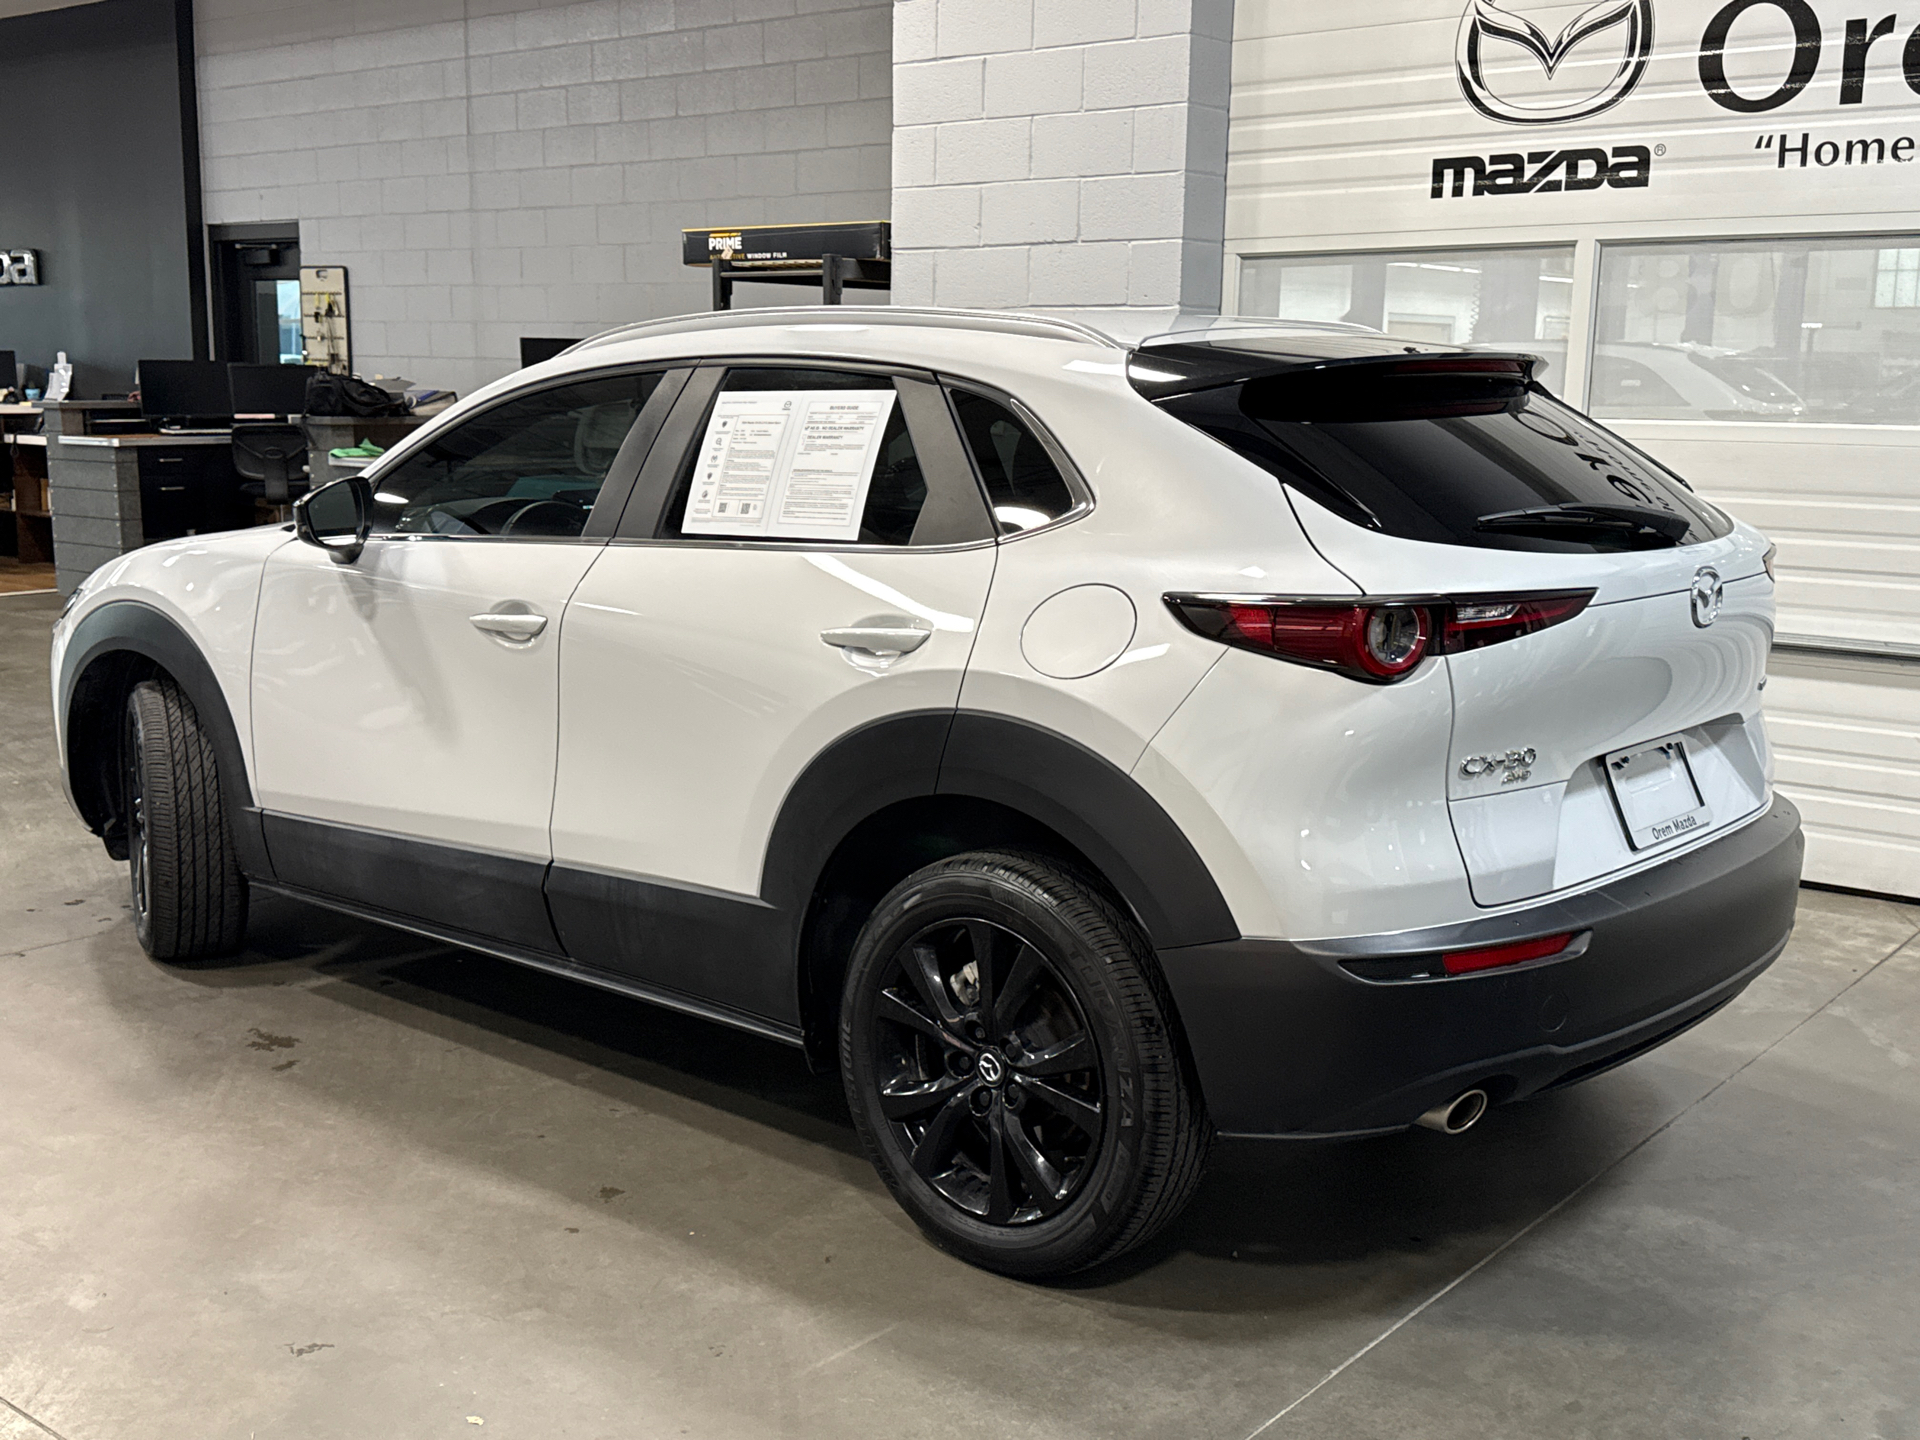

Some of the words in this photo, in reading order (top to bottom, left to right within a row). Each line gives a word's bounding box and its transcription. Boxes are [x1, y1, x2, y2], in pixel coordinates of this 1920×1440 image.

[1698, 0, 1920, 113] Or
[708, 237, 743, 251] PRIME
[1651, 823, 1674, 840] Orem
[1672, 814, 1698, 832] Mazda
